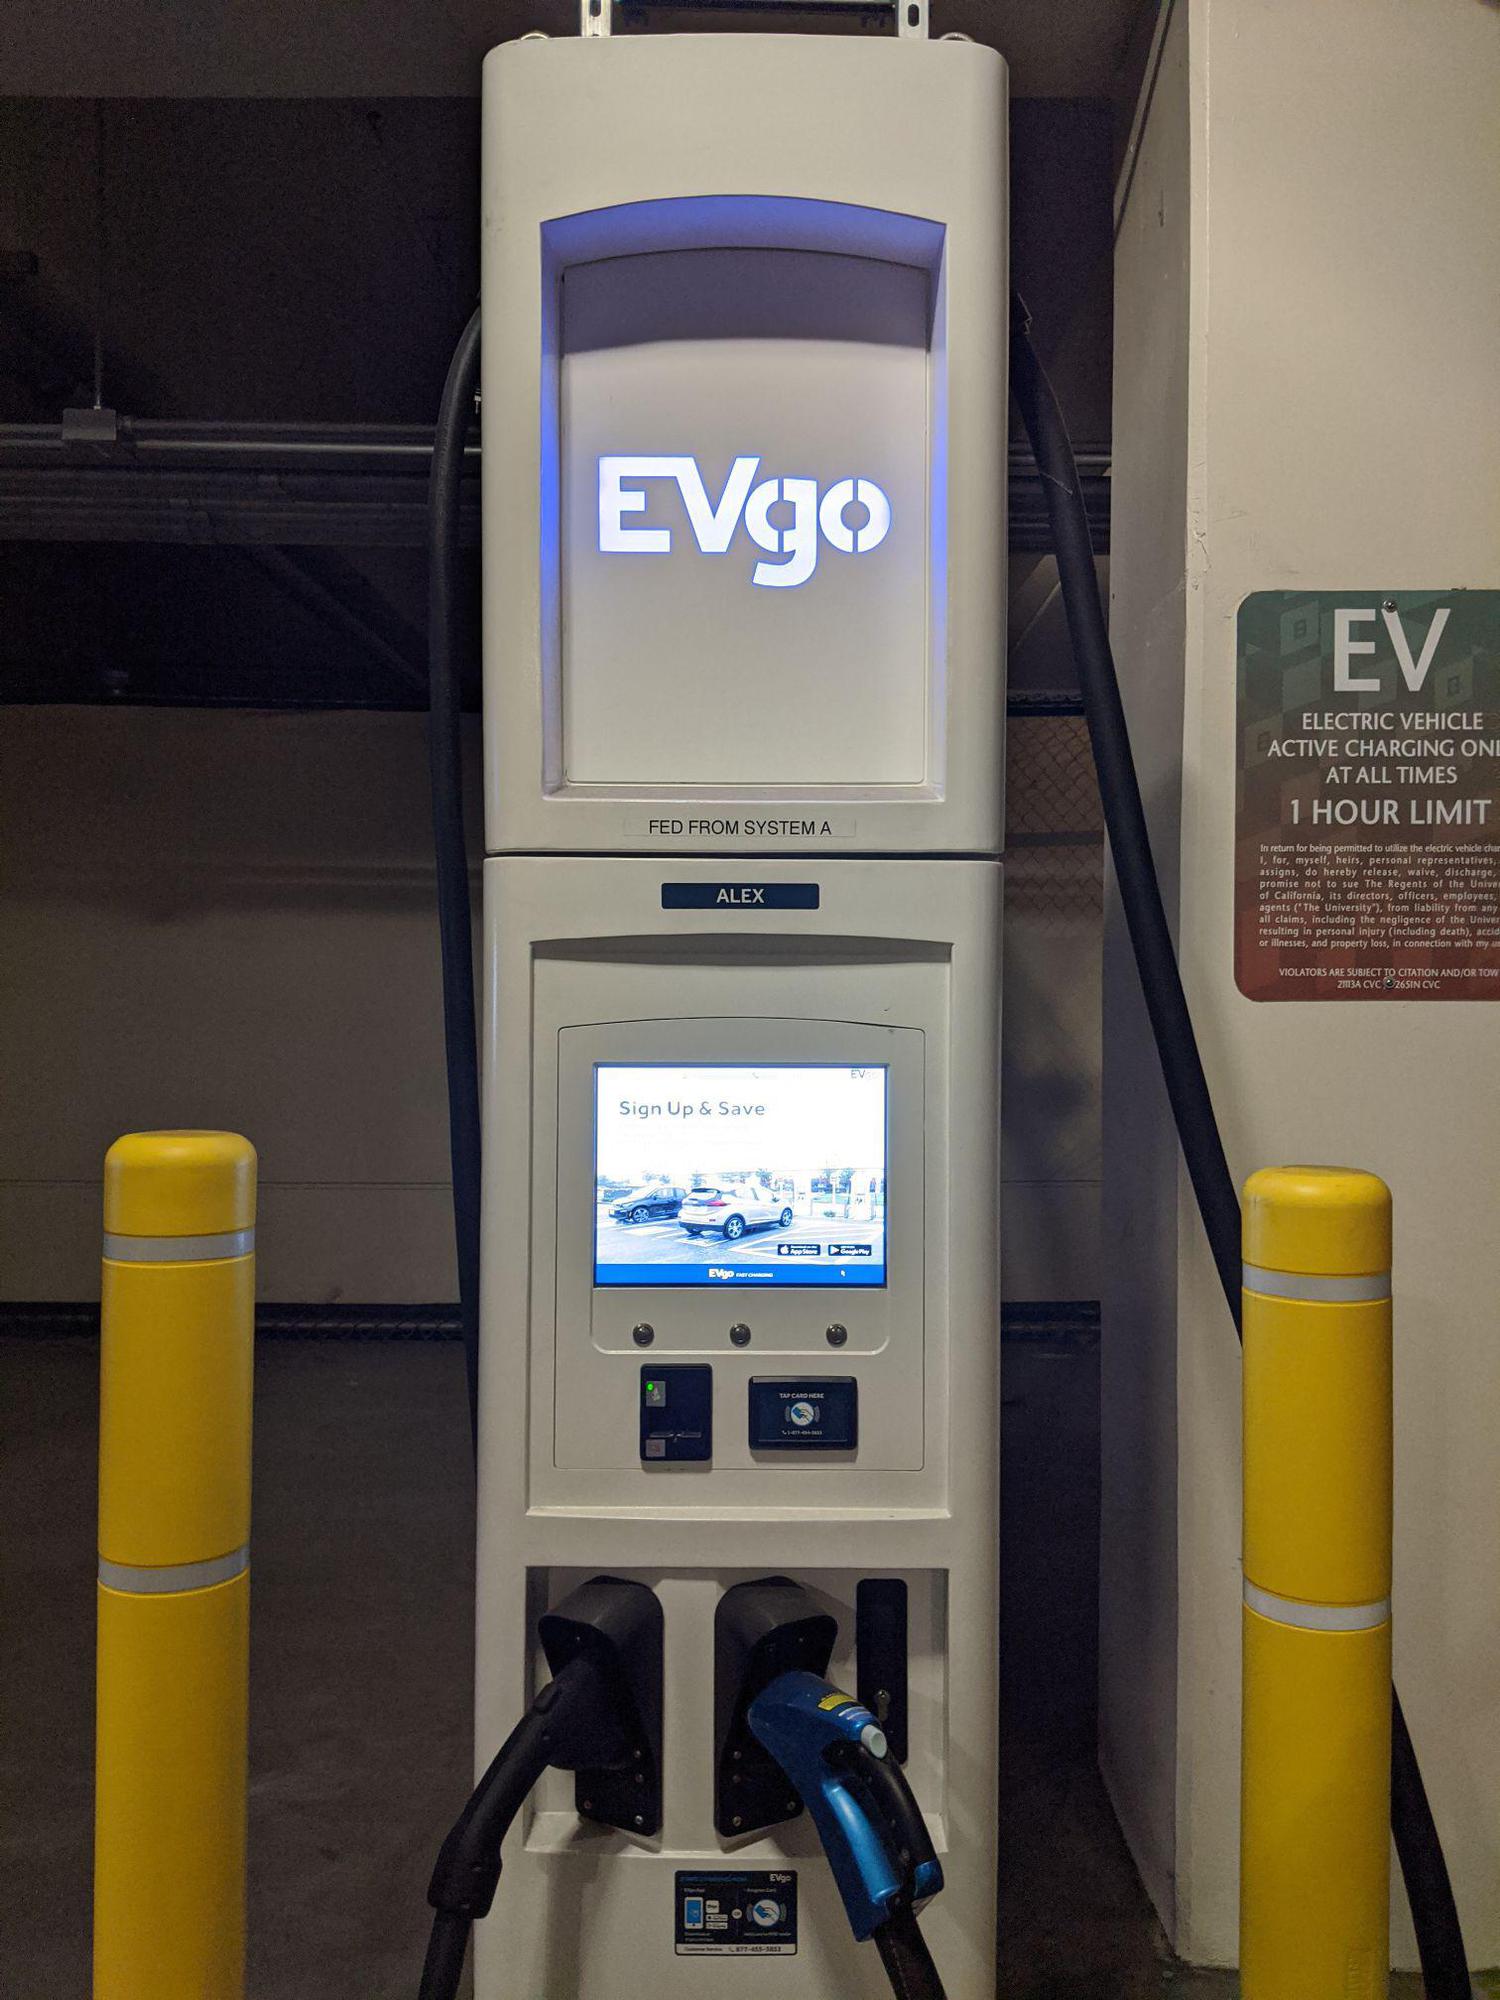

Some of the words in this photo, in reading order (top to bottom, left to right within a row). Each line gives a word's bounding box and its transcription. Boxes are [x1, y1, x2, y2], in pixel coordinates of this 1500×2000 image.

[599, 456, 892, 587] EVgo
[1334, 608, 1451, 692] EV
[1302, 712, 1394, 730] ELECTRIC
[1400, 712, 1484, 730] VEHICLE
[1267, 739, 1338, 757] ACTIVE
[1345, 739, 1454, 757] CHARGING
[1326, 766, 1353, 784] AT
[1355, 766, 1392, 784] ALL
[1396, 766, 1458, 784] TIMES
[1291, 799, 1299, 825] 1
[1312, 799, 1400, 825] HOUR
[1410, 799, 1492, 825] LIMIT
[649, 820, 683, 834] FED
[688, 820, 739, 834] FROM
[744, 820, 815, 835] SYSTEM
[820, 821, 832, 835] A
[1260, 844, 1269, 852] In
[1296, 844, 1308, 852] for
[1309, 844, 1332, 854] being
[1334, 844, 1373, 854] permitted
[1374, 844, 1383, 852] to
[1385, 844, 1408, 852] utilize
[1410, 844, 1423, 852] the
[1425, 844, 1454, 852] electric
[1456, 844, 1482, 852] vehicle
[1260, 856, 1267, 865] I,
[1273, 856, 1289, 865] for,
[1295, 856, 1330, 866] myself,
[1336, 856, 1363, 865] heirs,
[1369, 856, 1411, 866] personal
[1417, 856, 1497, 866] representatives,
[1260, 867, 1299, 878] assigns,
[1305, 867, 1318, 876] do
[1323, 867, 1357, 878] hereby
[1363, 867, 1401, 878] release,
[1407, 867, 1440, 878] waive,
[1444, 868, 1497, 879] discharge,
[1260, 880, 1299, 890] promise
[1304, 880, 1321, 888] not
[1327, 880, 1337, 888] to
[1364, 880, 1382, 888] The
[1388, 880, 1428, 891] Regents
[1433, 880, 1443, 888] of
[1449, 880, 1465, 888] the
[716, 888, 765, 904] ALEX
[1260, 891, 1270, 900] of
[1274, 891, 1324, 901] California,
[1329, 891, 1342, 900] its
[1346, 891, 1393, 901] directors,
[1398, 891, 1438, 901] officers,
[1443, 892, 1497, 902] employees,
[1260, 904, 1291, 914] agents
[1387, 903, 1410, 912] from
[1414, 903, 1450, 914] liability
[1454, 903, 1477, 912] from
[1481, 905, 1498, 914] any
[1259, 915, 1271, 924] all
[1275, 915, 1308, 925] claims,
[1312, 915, 1356, 926] including
[1360, 915, 1376, 924] the
[1380, 915, 1431, 926] negligence
[1435, 915, 1446, 924] of
[1450, 915, 1466, 924] the
[1259, 927, 1299, 937] resulting
[1303, 927, 1312, 935] in
[1316, 927, 1355, 937] personal
[1359, 927, 1386, 937] injury
[1388, 927, 1436, 937] (including
[1440, 927, 1472, 937] death),
[1271, 938, 1309, 948] illnesses,
[1312, 939, 1328, 947] and
[1330, 939, 1368, 949] property
[1371, 939, 1389, 949] loss,
[1393, 939, 1401, 947] in
[1404, 939, 1452, 947] connection
[1454, 939, 1473, 947] with
[1476, 941, 1489, 950] my
[1279, 968, 1327, 976] VIOLATORS
[1329, 968, 1345, 976] ARE
[1347, 968, 1382, 976] SUBJECT
[1384, 968, 1396, 976] TO
[1398, 968, 1439, 976] CITATION
[1440, 968, 1477, 978] AND/OR
[1363, 980, 1381, 989] CVC
[1422, 980, 1440, 989] CVC
[619, 1100, 662, 1119] Sign
[667, 1101, 694, 1118] Up
[699, 1101, 712, 1116] &
[718, 1101, 765, 1116] Save
[708, 1268, 735, 1280] EVgo
[769, 1873, 792, 1884] EVgo
